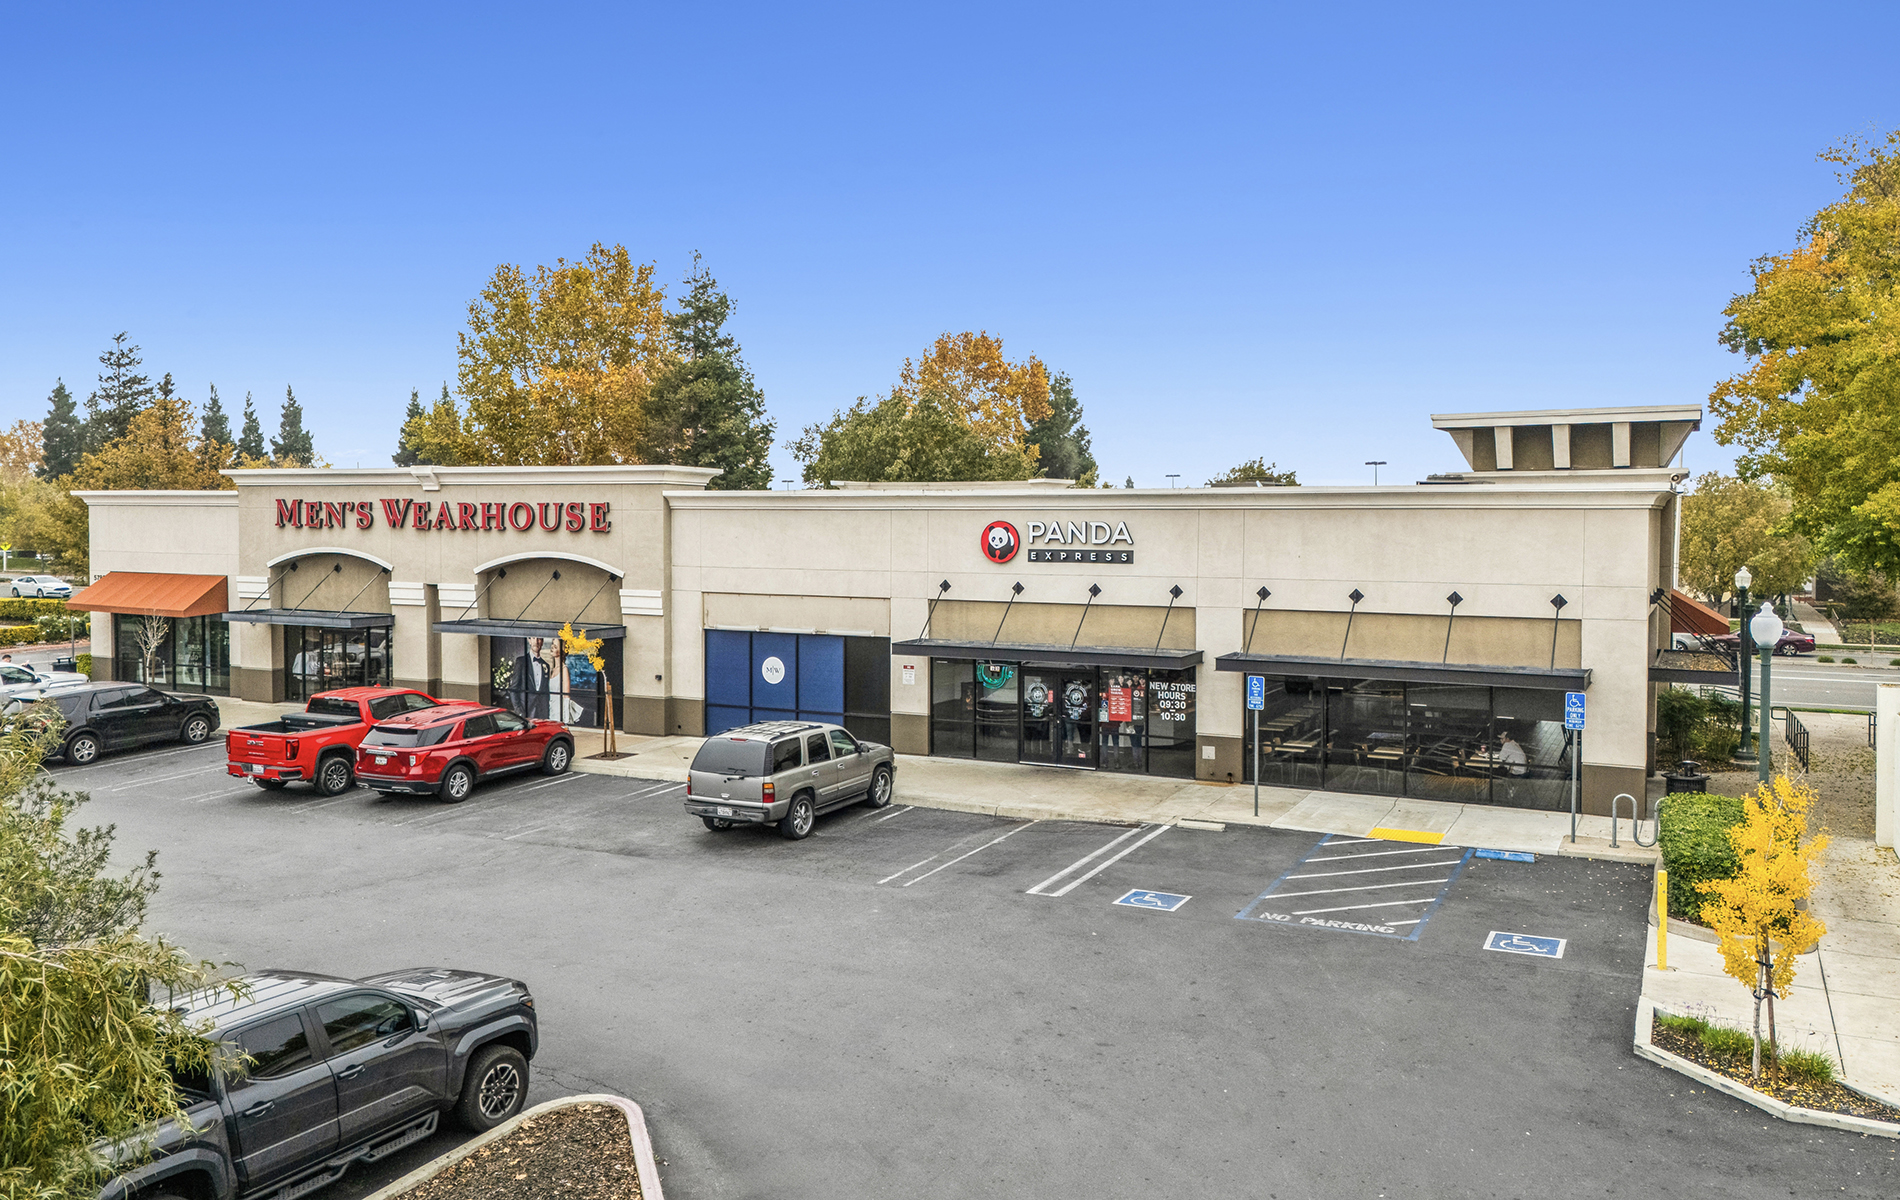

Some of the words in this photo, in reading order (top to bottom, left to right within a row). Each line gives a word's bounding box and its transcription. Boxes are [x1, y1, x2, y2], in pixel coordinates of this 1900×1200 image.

[275, 498, 373, 529] MEN'S
[380, 498, 611, 533] WEARHOUSE
[1026, 520, 1134, 545] PANDA
[1030, 551, 1129, 562] EXPRESS
[1149, 682, 1169, 691] NEW
[1170, 683, 1197, 693] STORE
[1157, 691, 1186, 700] HOURS
[1159, 700, 1187, 709] 09:30
[1160, 712, 1186, 722] 10:30
[1259, 911, 1292, 921] NO
[1300, 916, 1397, 934] PARKING
